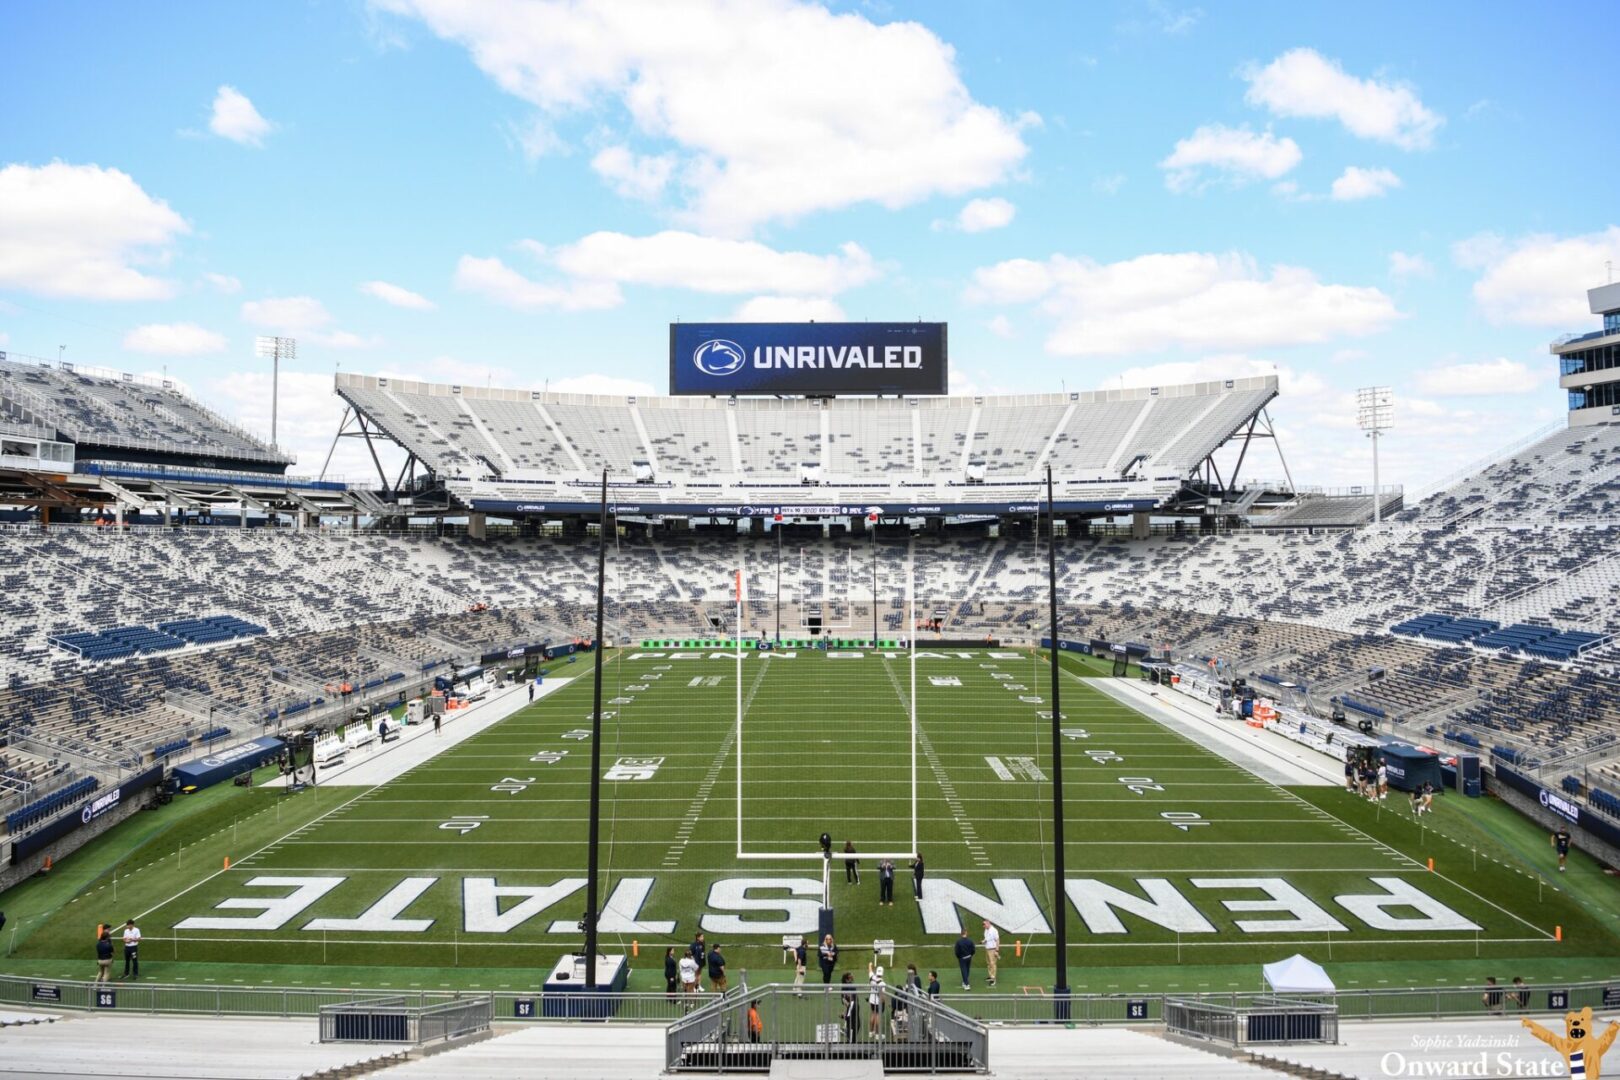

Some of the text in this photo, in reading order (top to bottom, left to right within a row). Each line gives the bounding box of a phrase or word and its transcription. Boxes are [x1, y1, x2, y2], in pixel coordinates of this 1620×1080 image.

[754, 346, 922, 369] UNRIVALED
[627, 651, 1026, 660] PENN STATE
[529, 750, 569, 761] 30
[1084, 750, 1124, 762] 30
[490, 777, 536, 791] 20
[1118, 777, 1165, 791] 20
[438, 815, 489, 829] 10
[1160, 812, 1210, 826] 10
[172, 875, 1484, 935] PENN STATE
[100, 994, 112, 1005] SG
[519, 1004, 530, 1015] SF
[1132, 1005, 1143, 1016] SE
